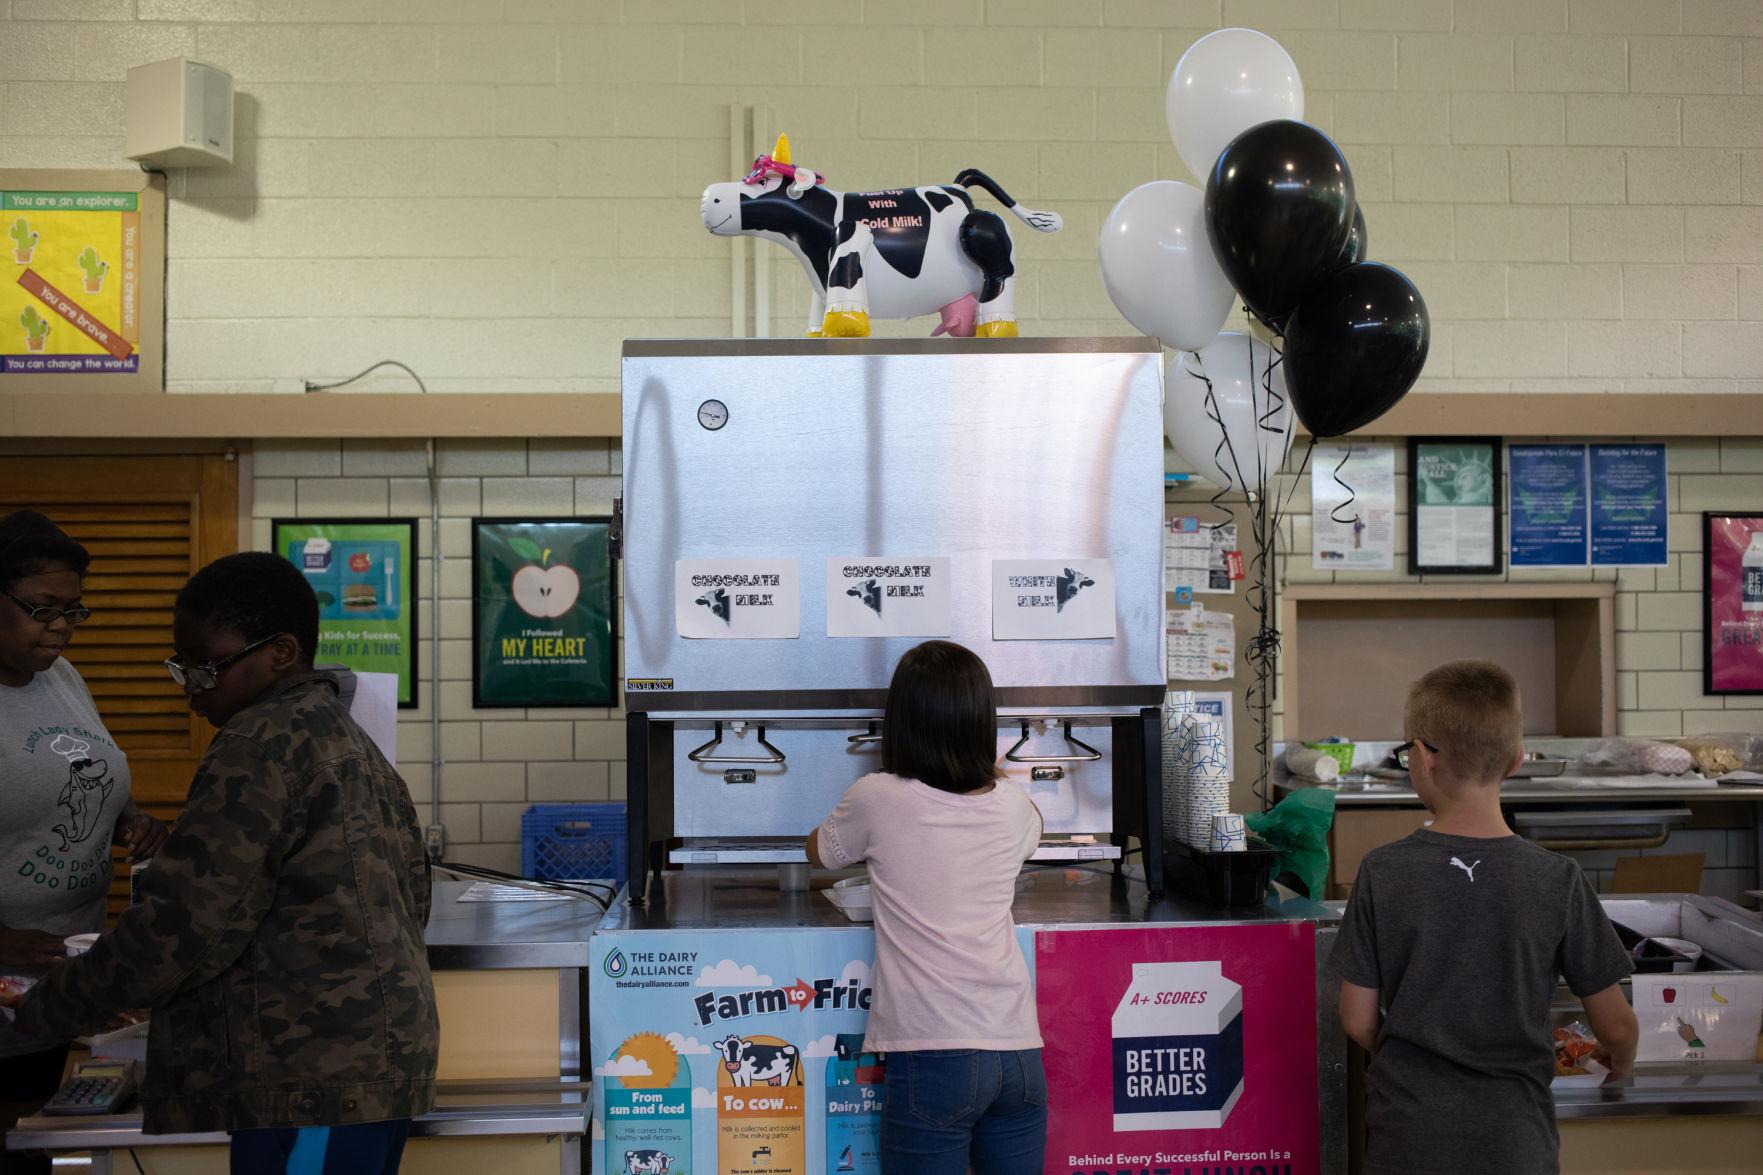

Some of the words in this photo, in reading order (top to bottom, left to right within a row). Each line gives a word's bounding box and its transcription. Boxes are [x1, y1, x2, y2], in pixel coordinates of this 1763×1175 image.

[13, 195, 32, 206] You
[36, 196, 56, 207] are
[59, 196, 74, 207] an
[76, 195, 129, 207] explorer.
[868, 200, 898, 209] With
[860, 217, 889, 229] Cold
[892, 216, 923, 228] Milk!
[125, 226, 136, 246] You
[125, 250, 134, 269] are
[125, 272, 134, 280] a
[41, 286, 58, 305] You
[58, 301, 77, 319] are
[77, 314, 109, 344] brave.
[8, 359, 26, 369] You
[27, 360, 45, 369] can
[47, 359, 83, 370] change
[85, 359, 101, 369] the
[104, 359, 136, 369] world.
[842, 565, 931, 578] CHOCOLATE
[691, 574, 780, 587] CHOCOLATE
[1008, 575, 1056, 588] WHITE
[886, 584, 925, 597] MILK
[735, 594, 774, 606] MILK
[1017, 595, 1056, 607] MILK
[324, 631, 345, 640] Kids
[347, 630, 360, 640] for
[521, 629, 526, 637] I
[527, 629, 564, 637] Followed
[346, 642, 359, 656] AT
[362, 643, 369, 656] A
[373, 642, 401, 656] TIME
[502, 638, 527, 657] MY
[532, 637, 587, 657] HEART
[36, 844, 65, 870] Doo
[71, 859, 95, 873] Doo
[17, 859, 60, 889] Doo
[67, 872, 97, 890] Doo
[630, 952, 655, 963] THE
[658, 952, 699, 963] DAIRY
[630, 965, 694, 976] ALLIANCE
[616, 980, 690, 989] thedairyalliance.com
[1130, 992, 1151, 1006] A+
[1154, 991, 1208, 1005] SCORES
[694, 986, 790, 1029] Farm
[789, 988, 807, 1002] to
[1126, 1047, 1207, 1074] BETTER
[1685, 1051, 1699, 1059] Pick
[1700, 1051, 1705, 1059] 1
[1126, 1072, 1207, 1098] GRADES
[632, 1092, 663, 1103] From
[861, 1087, 876, 1099] To
[609, 1106, 630, 1115] sun
[631, 1104, 656, 1115] and
[658, 1103, 685, 1114] feed
[723, 1095, 744, 1112] To
[828, 1101, 861, 1114] Dairy
[722, 1125, 733, 1133] Milk
[740, 1124, 768, 1132] collected
[768, 1124, 780, 1132] and
[780, 1124, 801, 1132] cooled
[750, 1132, 771, 1140] milking
[771, 1132, 791, 1140] parlor.
[1068, 1155, 1113, 1167] Behind
[1116, 1153, 1152, 1167] Every
[1155, 1150, 1221, 1164] Successful
[1224, 1150, 1267, 1161] Person
[1283, 1152, 1291, 1160] a
